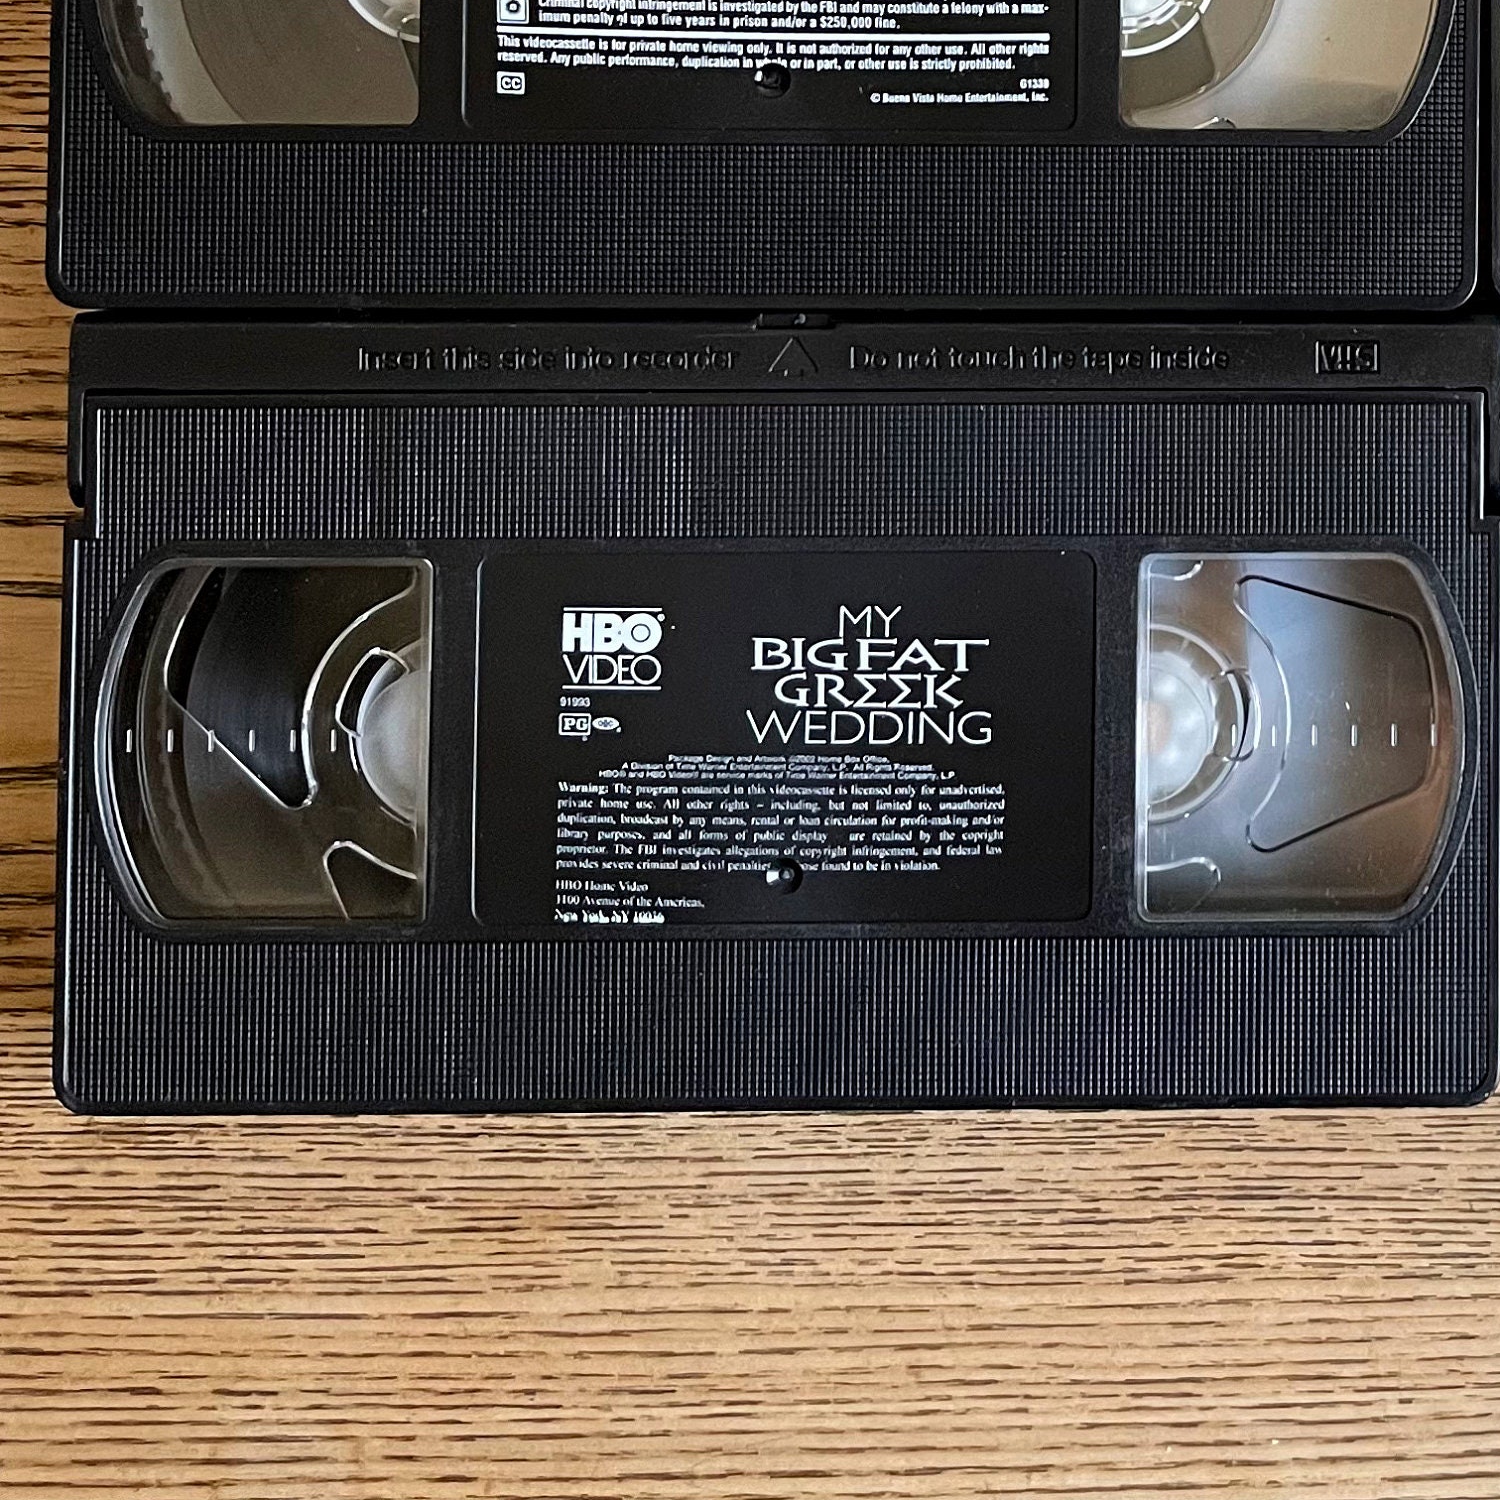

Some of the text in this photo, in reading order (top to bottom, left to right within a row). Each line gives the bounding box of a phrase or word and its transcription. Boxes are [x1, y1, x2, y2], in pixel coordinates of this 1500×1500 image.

[500, 76, 522, 90] CC
[562, 612, 663, 653] HBO
[838, 605, 901, 638] MY
[562, 653, 662, 685] VIDEO
[750, 636, 989, 673] BIG FAT
[562, 716, 589, 731] PG
[745, 709, 991, 745] WEDDING
[555, 879, 648, 891] HBO Home Video
